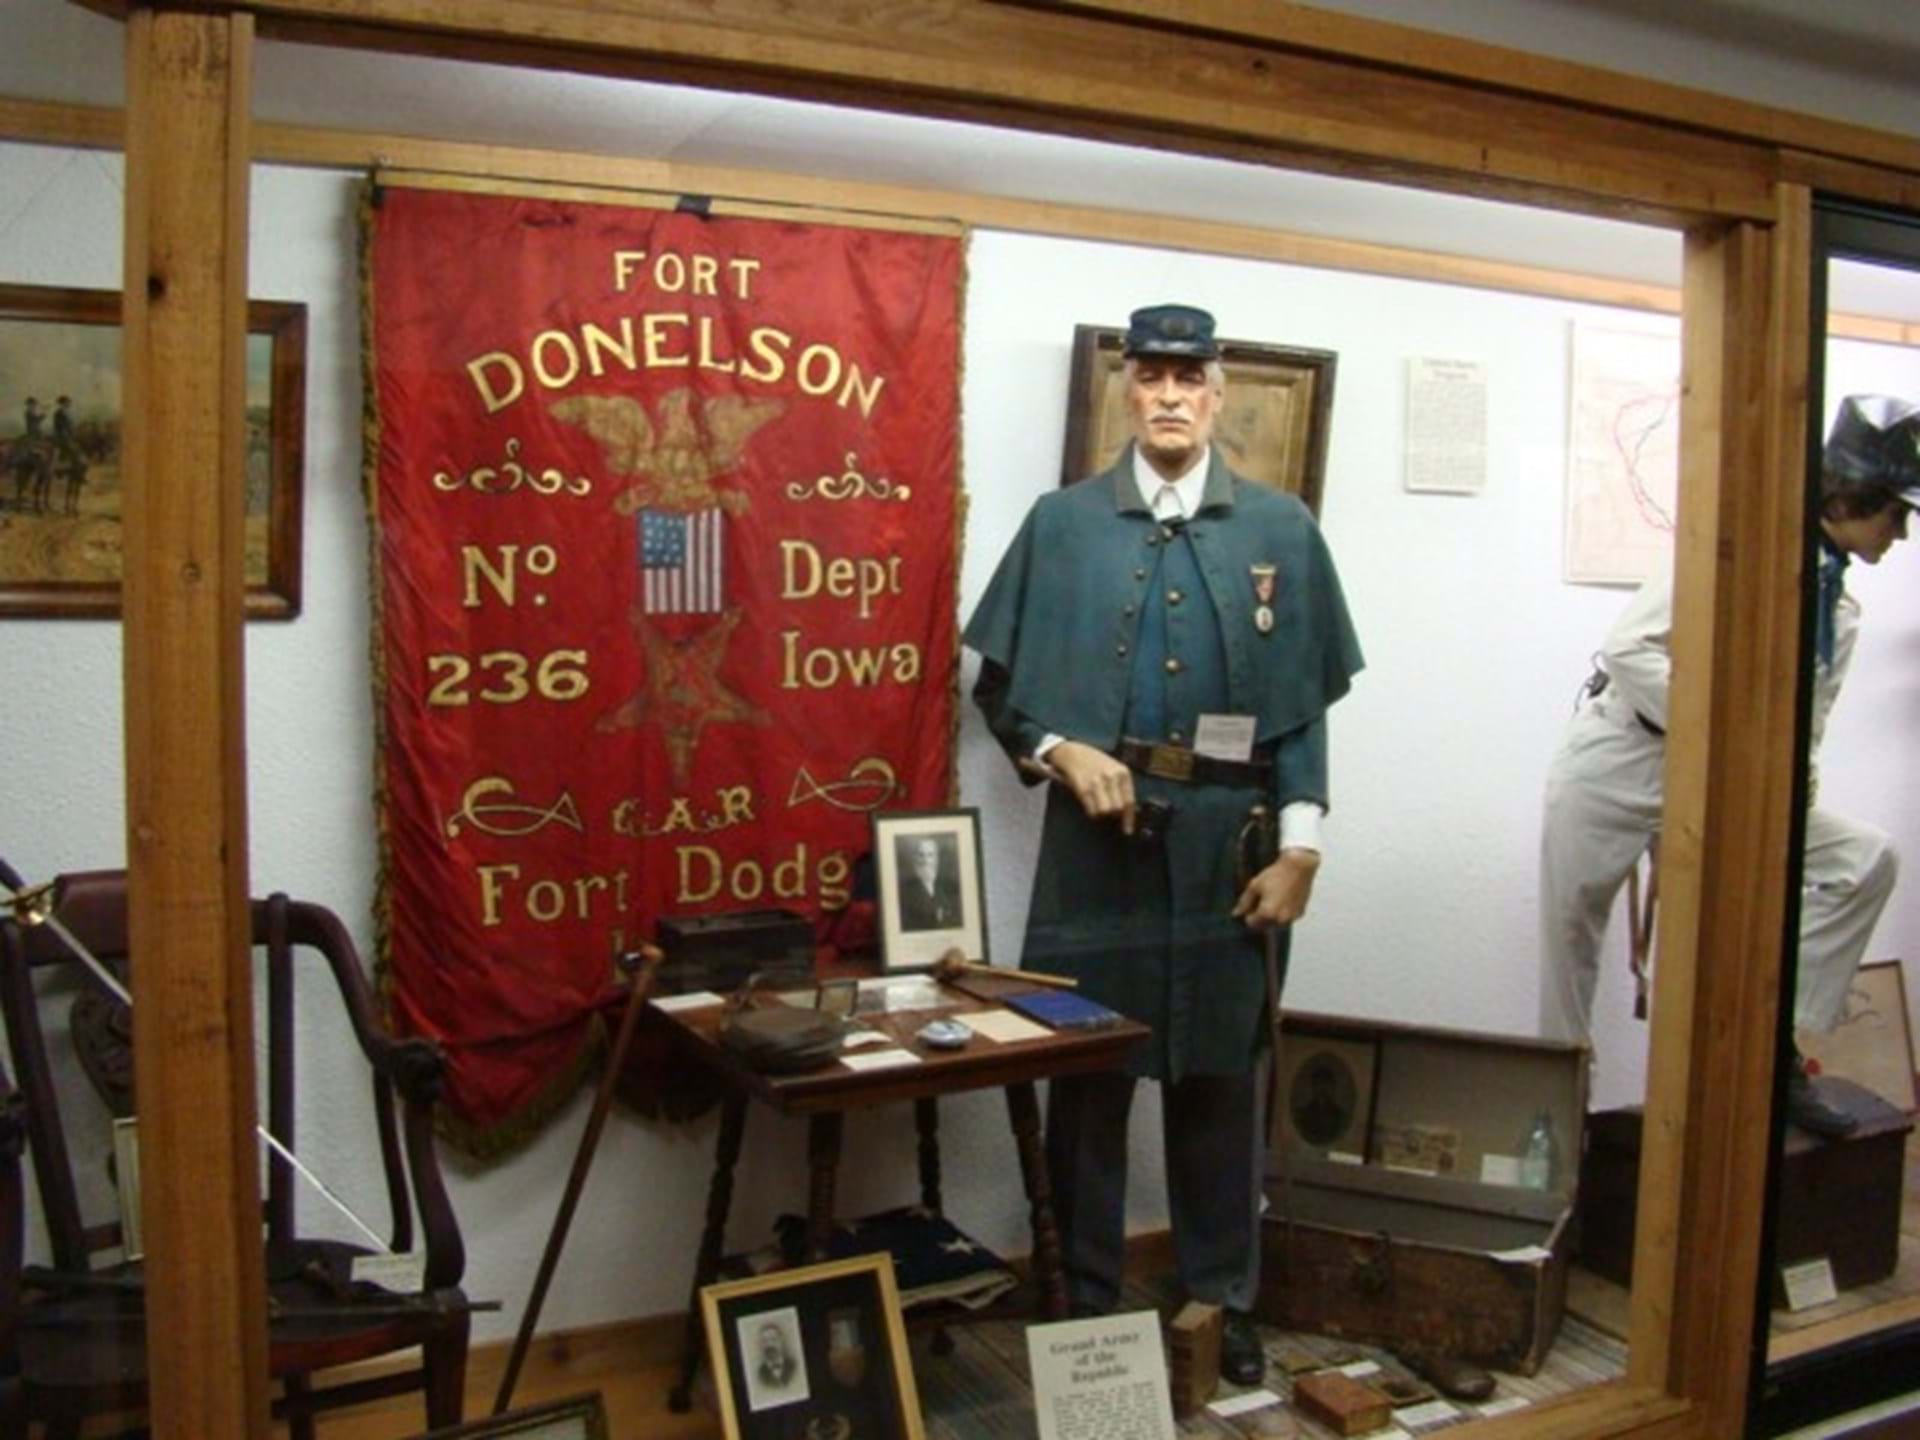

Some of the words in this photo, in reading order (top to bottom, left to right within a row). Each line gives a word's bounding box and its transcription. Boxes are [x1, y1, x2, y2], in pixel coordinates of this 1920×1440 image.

[613, 250, 760, 299] FORT
[467, 312, 884, 418] DONELSON
[781, 540, 902, 619] Dept
[427, 649, 589, 706] 236
[781, 631, 920, 690] Iowa
[477, 864, 630, 926] Fort
[676, 843, 850, 911] Dodg
